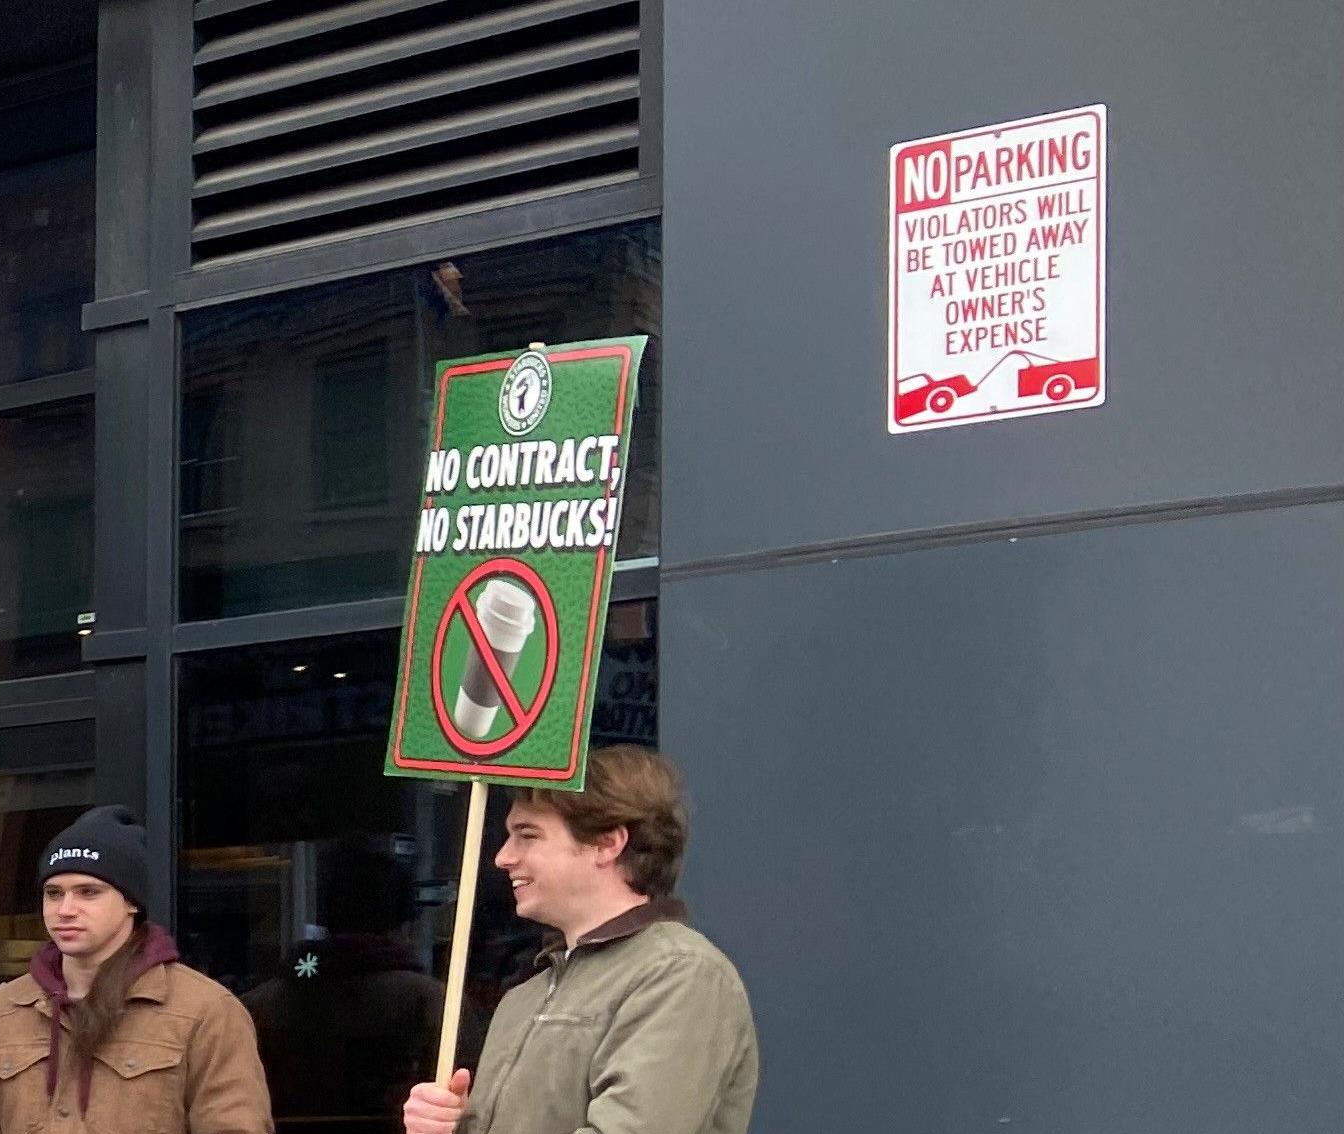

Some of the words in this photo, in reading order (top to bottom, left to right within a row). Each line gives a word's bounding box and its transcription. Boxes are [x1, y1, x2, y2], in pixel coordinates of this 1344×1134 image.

[904, 149, 948, 205] NO
[955, 131, 1092, 193] PARKING
[905, 199, 1027, 242] VIOLATORS
[1037, 189, 1091, 220] WILL
[907, 247, 933, 272] BE
[942, 232, 1017, 267] TOWED
[1026, 219, 1089, 251] AWAY
[930, 273, 956, 299] AT
[965, 254, 1060, 293] VEHICLE
[946, 287, 1045, 325] OWNER'S
[946, 317, 1048, 356] EXPENSE
[425, 449, 461, 493] NO
[466, 435, 621, 491] CONTRACT,
[416, 506, 450, 553] NO
[453, 497, 619, 551] STARBUCKS!
[49, 848, 99, 865] plants
